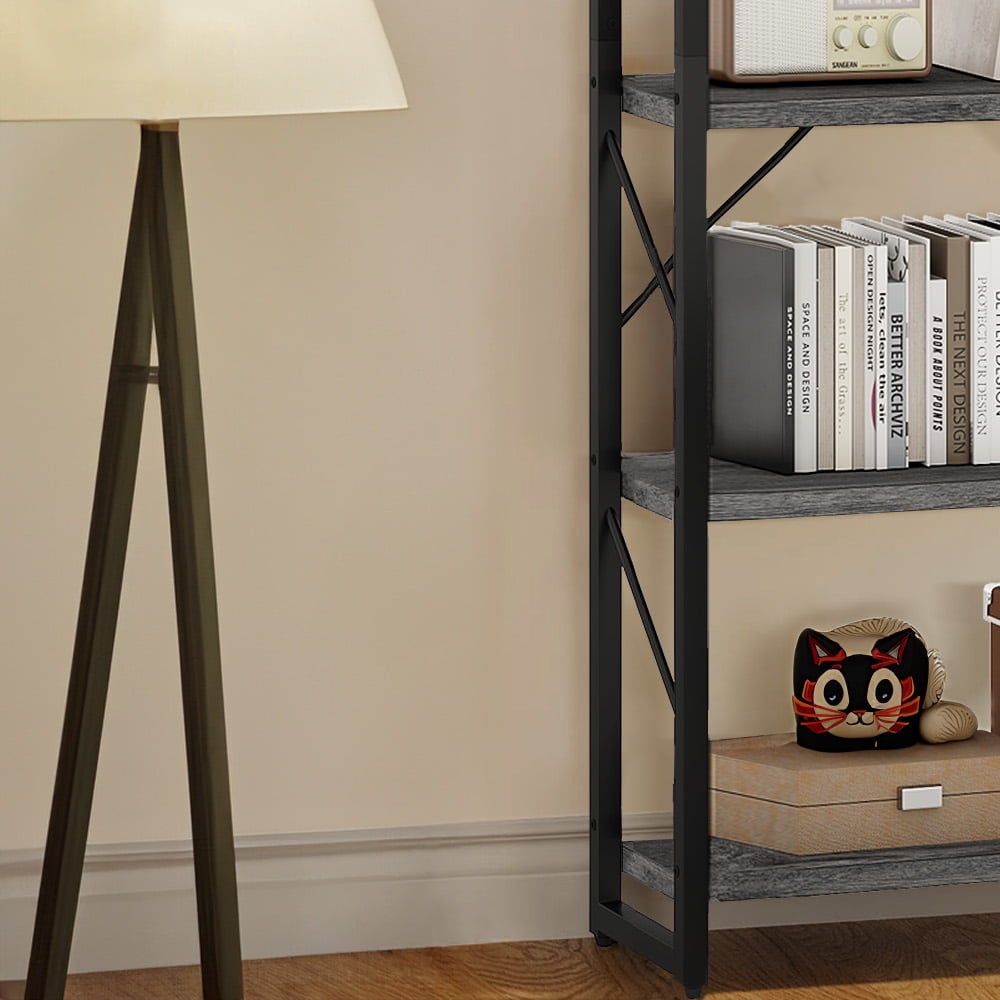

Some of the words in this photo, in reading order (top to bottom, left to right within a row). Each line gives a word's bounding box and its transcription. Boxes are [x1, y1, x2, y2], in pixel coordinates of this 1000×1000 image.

[839, 292, 848, 312] The
[977, 277, 988, 343] PROTECT
[802, 302, 810, 338] SPACE
[839, 318, 848, 335] art
[953, 311, 966, 342] THE
[802, 343, 810, 367] AND
[839, 343, 848, 356] of
[878, 329, 886, 369] clean
[891, 314, 903, 369] BETTER
[932, 327, 942, 354] BOOK
[839, 361, 848, 380] the
[932, 357, 942, 390] ABOUT
[953, 347, 966, 388] NEXT
[977, 346, 988, 379] OUR
[802, 371, 810, 413] DESIGN
[878, 374, 886, 399] the
[878, 403, 886, 423] air
[891, 373, 903, 438] ARCHVIZ
[932, 395, 942, 432] POINTS
[977, 382, 988, 436] DESIGN
[953, 394, 966, 454] DESIGN
